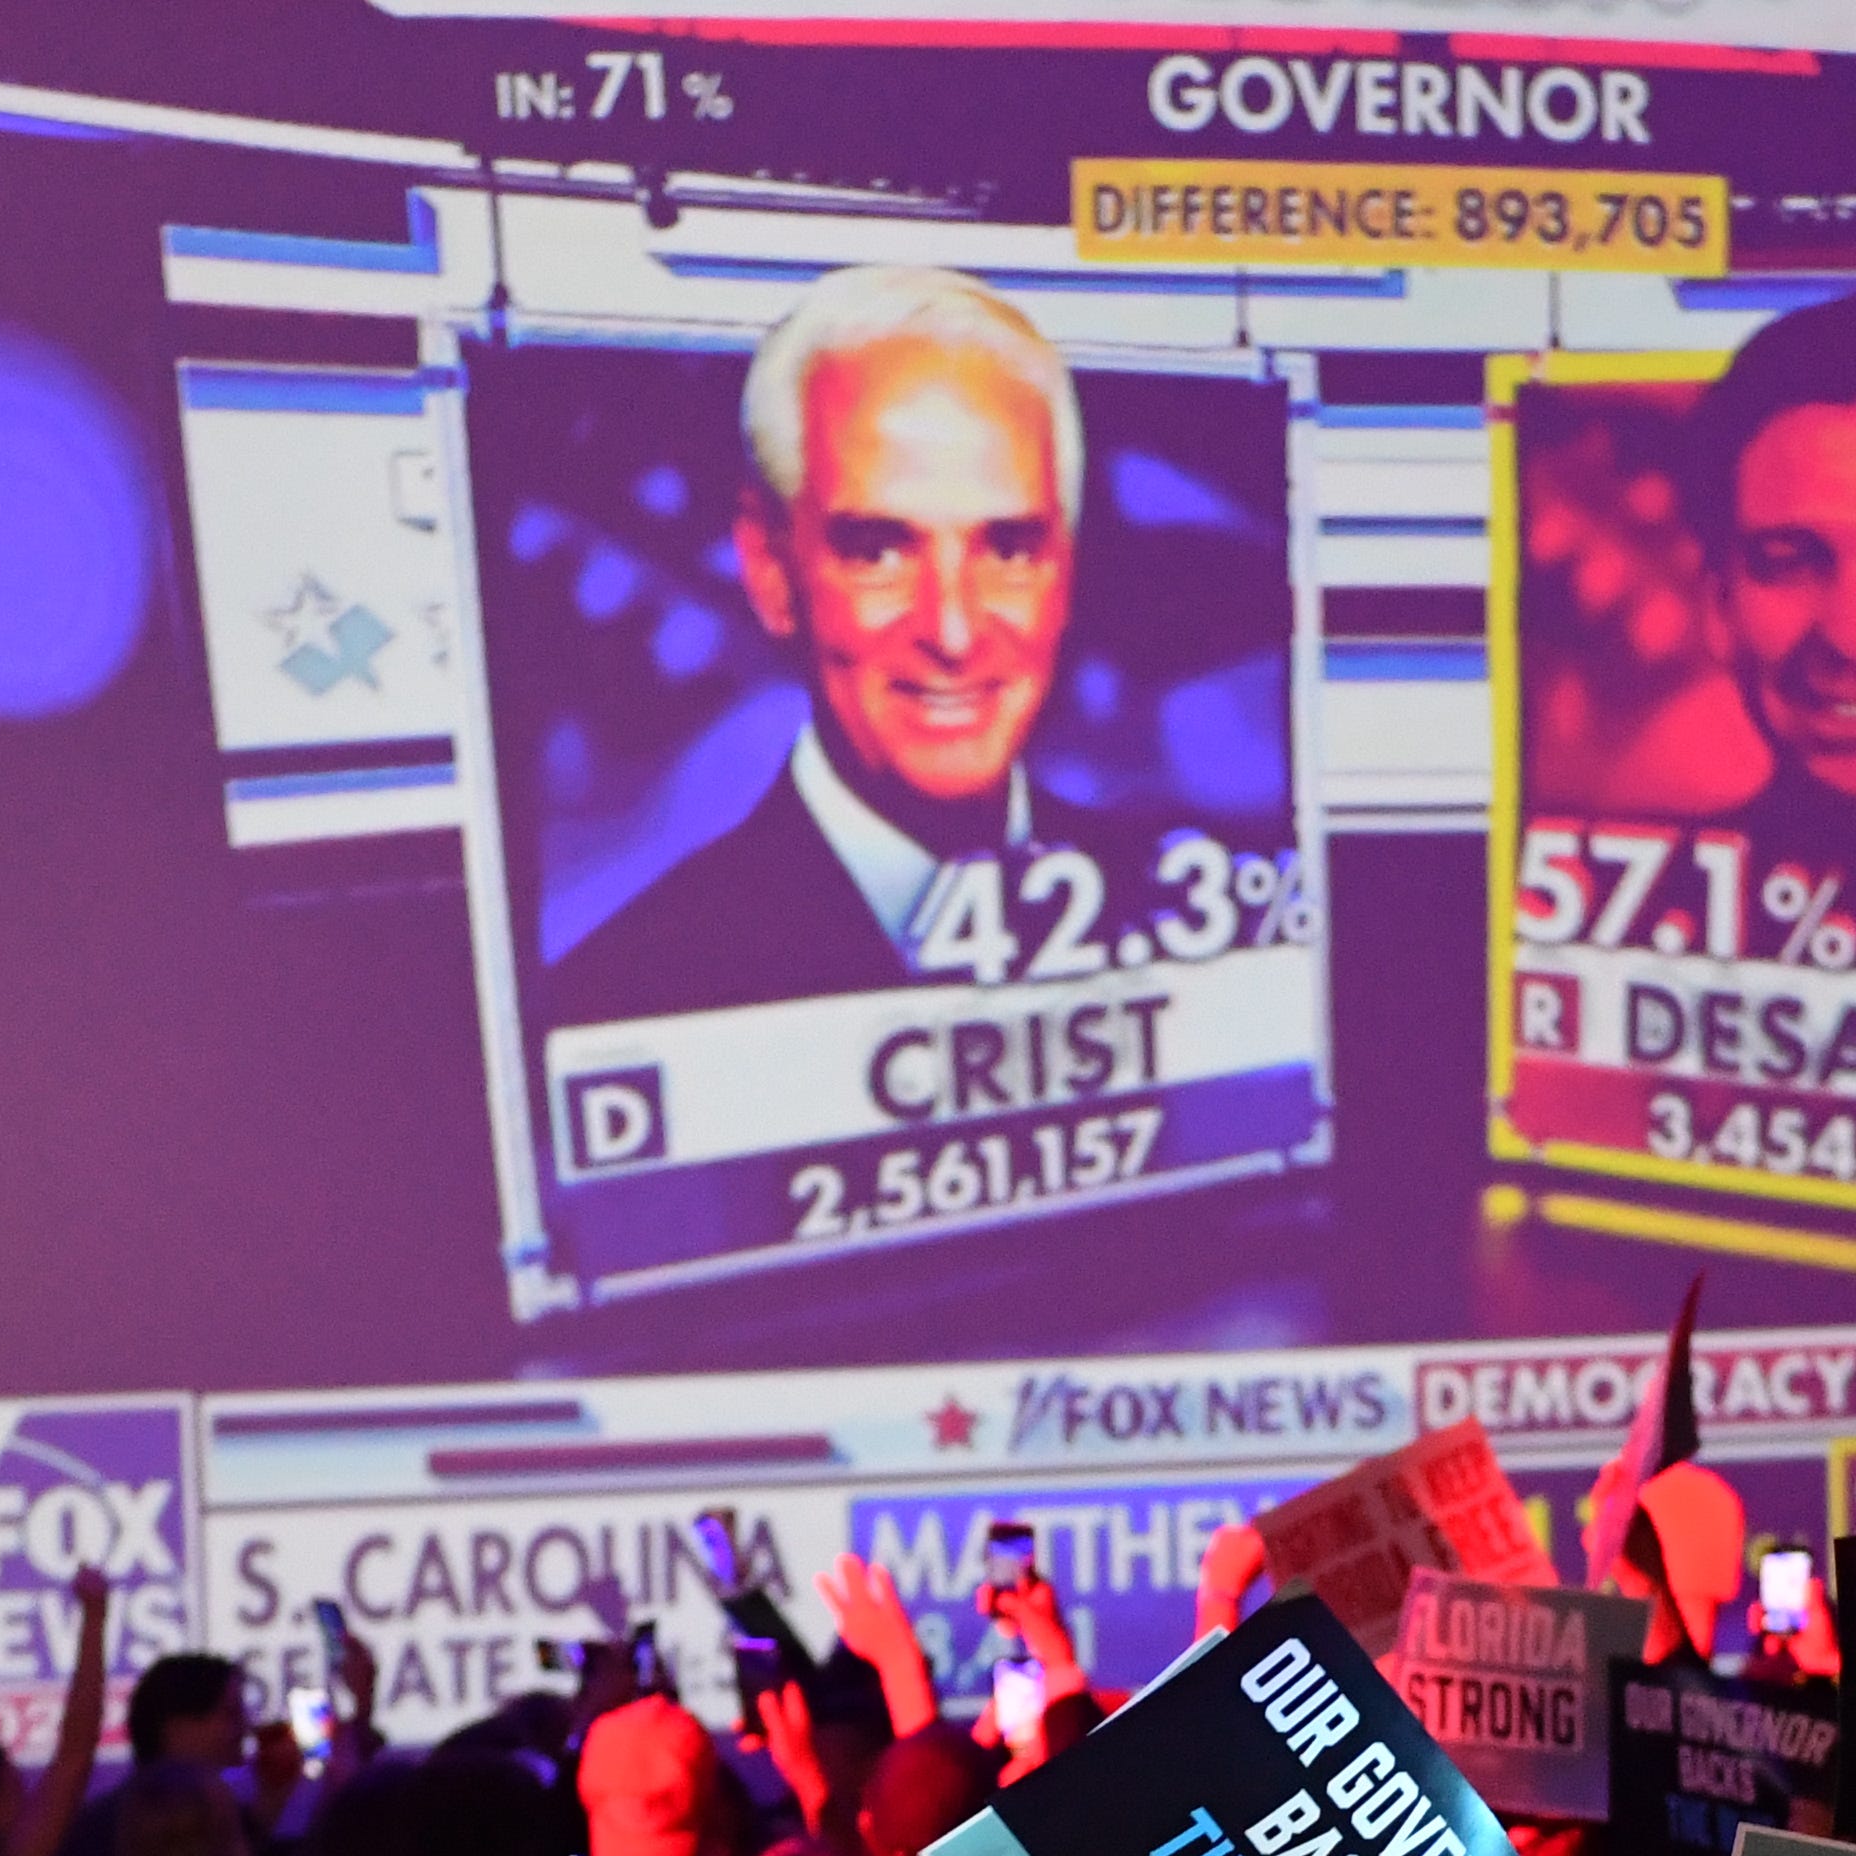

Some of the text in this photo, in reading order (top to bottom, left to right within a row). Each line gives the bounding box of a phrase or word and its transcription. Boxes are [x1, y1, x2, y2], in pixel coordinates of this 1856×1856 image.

[495, 72, 574, 119] IN:
[585, 53, 666, 119] 71
[1147, 54, 1650, 143] GOVERNOR
[1092, 183, 1706, 253] DIFFERENCE: 893,705
[919, 834, 1317, 984] 42.3%
[1520, 983, 1562, 1046] R
[867, 995, 1171, 1120] CRIST
[579, 1083, 652, 1161] D
[789, 1110, 1164, 1241] 2,561,157
[1062, 1385, 1186, 1447] FOX
[1202, 1373, 1387, 1434] NEWS
[236, 1538, 304, 1627] S.
[1407, 1598, 1588, 1675] FLORIDA
[1240, 1637, 1361, 1768] OUR
[1410, 1671, 1578, 1745] STRONG
